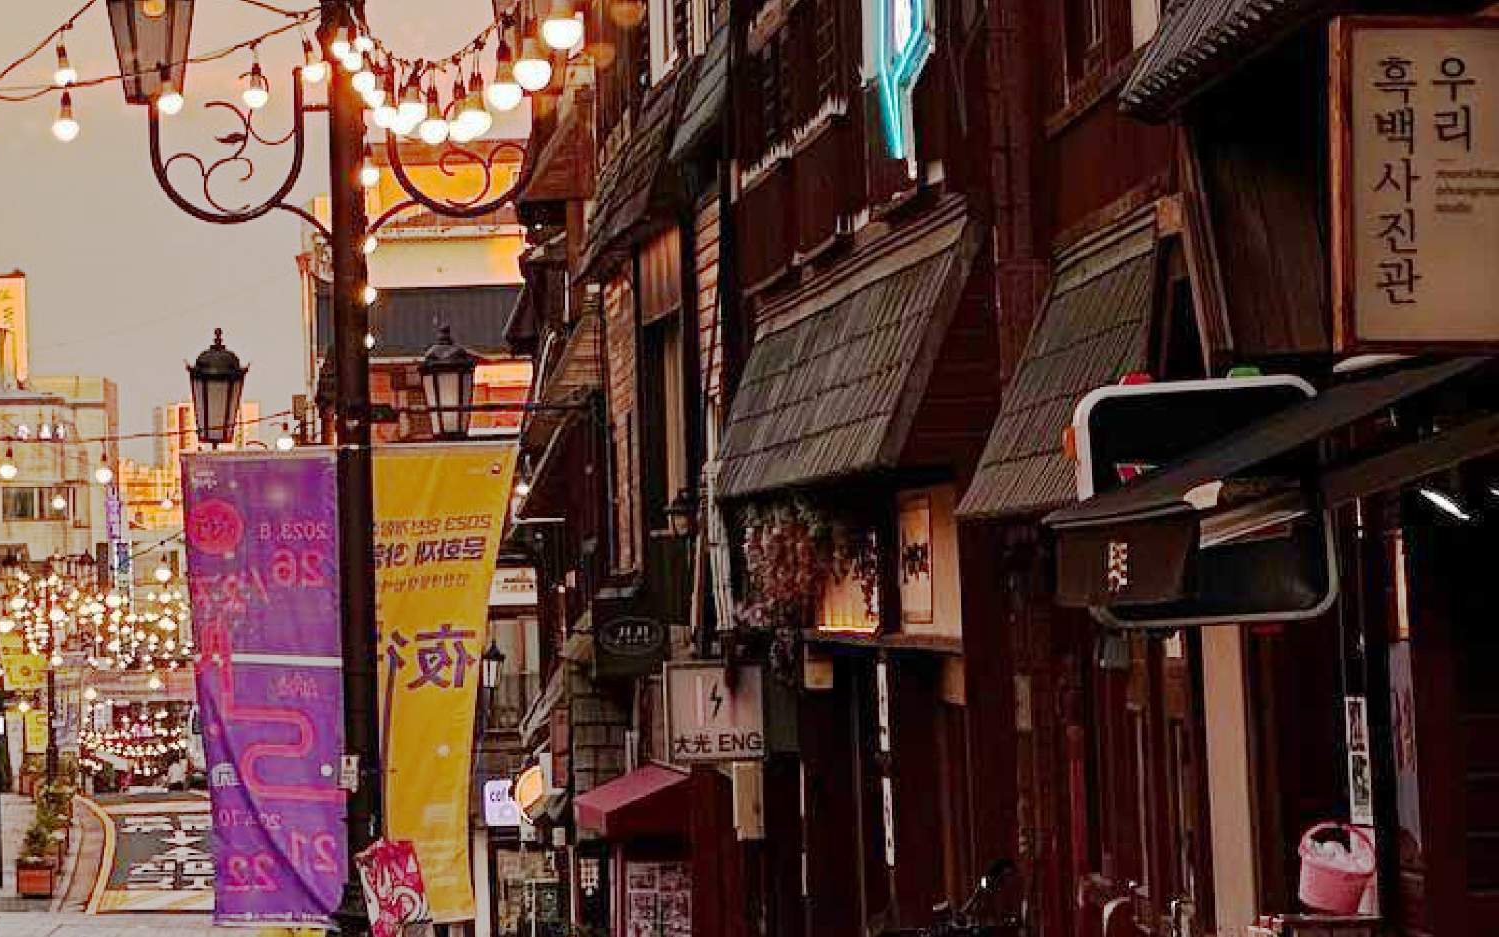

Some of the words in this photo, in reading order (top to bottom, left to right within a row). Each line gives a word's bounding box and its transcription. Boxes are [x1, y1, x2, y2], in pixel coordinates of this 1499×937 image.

[1432, 57, 1476, 152] 우리
[1373, 57, 1422, 304] 흑백사진관
[674, 732, 712, 754] 大光
[718, 731, 763, 752] ENG
